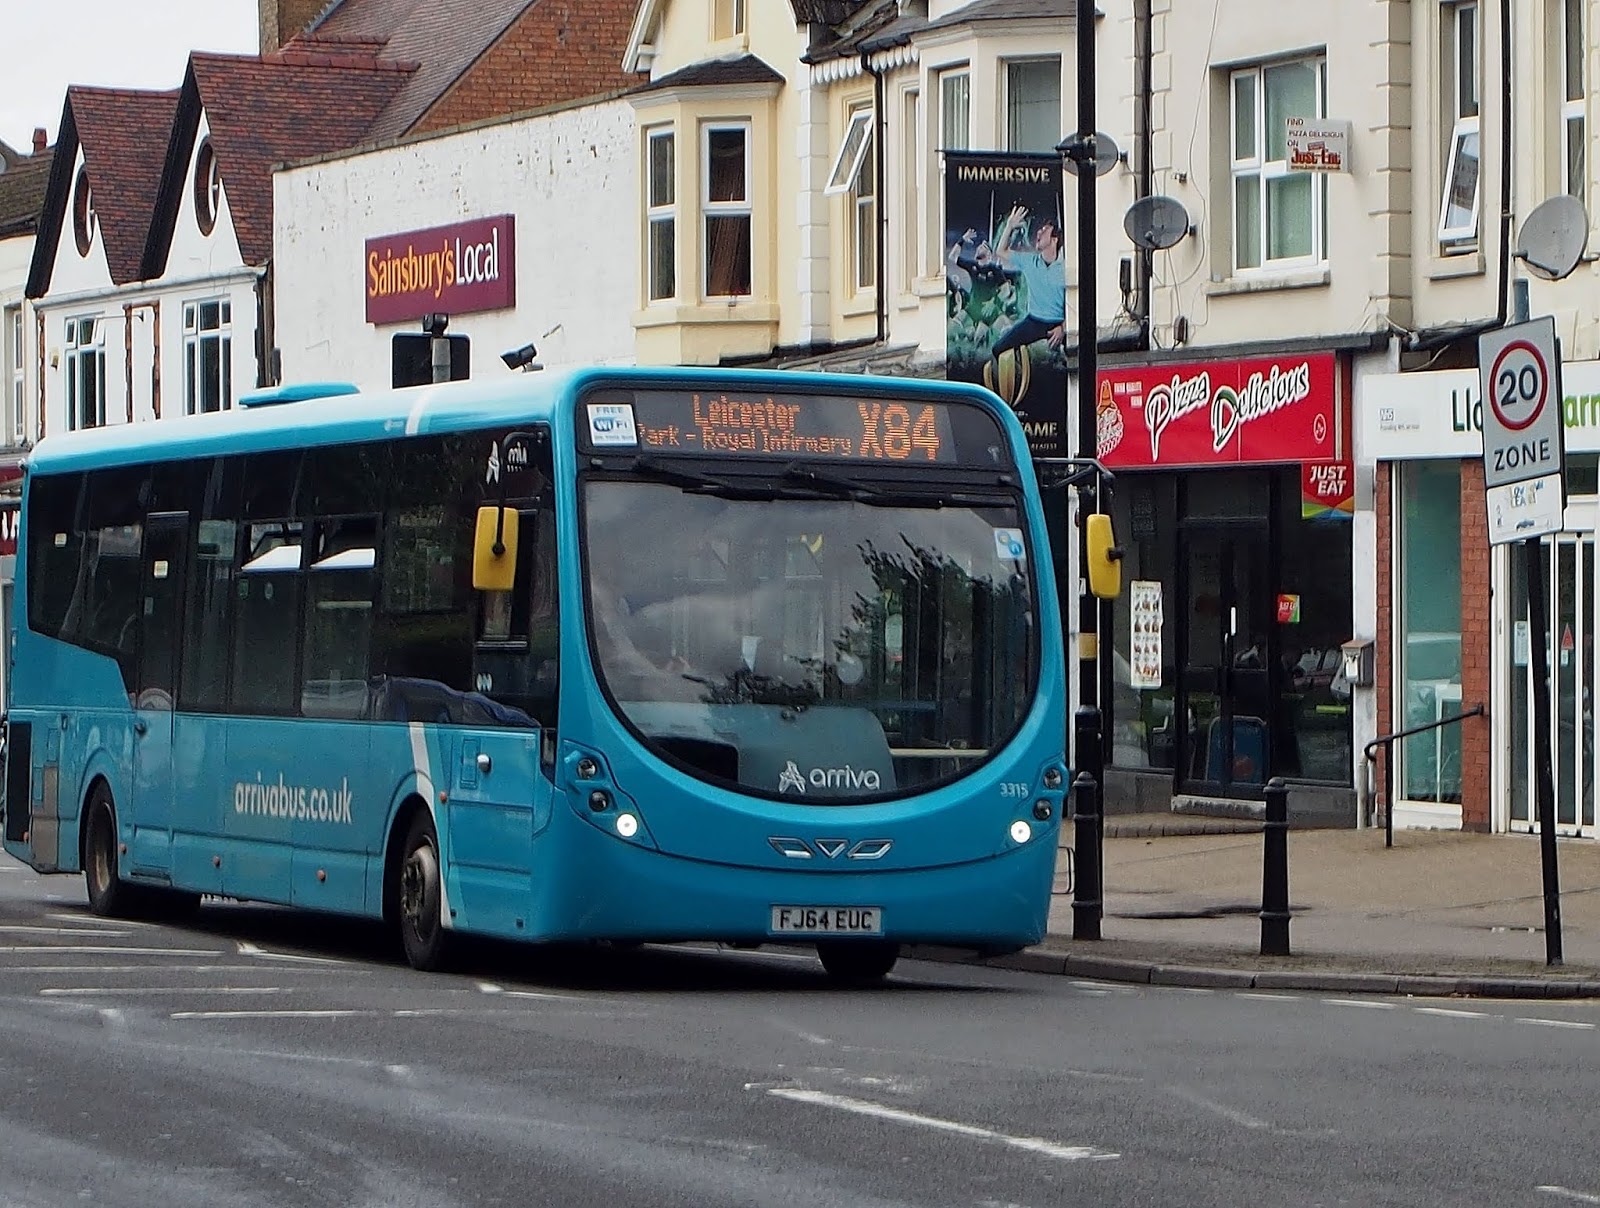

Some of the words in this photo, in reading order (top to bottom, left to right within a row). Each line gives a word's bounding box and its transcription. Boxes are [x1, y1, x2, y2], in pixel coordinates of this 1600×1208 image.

[1309, 130, 1344, 138] DELICIOUS
[957, 166, 1050, 183] IMMERSIVE
[369, 239, 454, 298] Sainsbury's
[455, 227, 499, 285] Local
[1499, 364, 1538, 407] 20
[595, 406, 624, 414] FREE
[692, 394, 800, 430] Leicester
[1144, 371, 1211, 462] Pizza
[1211, 362, 1311, 453] Delicious
[702, 424, 756, 451] Royal
[762, 429, 851, 456] Infirmary
[858, 402, 941, 461] X84
[1022, 421, 1058, 437] AME
[1494, 439, 1551, 472] ZONE
[1310, 466, 1346, 482] JUST
[1317, 480, 1346, 496] EAT
[809, 764, 880, 790] arriva
[235, 770, 352, 825] arrivabus.co.uk
[780, 909, 829, 929] FJ64
[836, 910, 873, 930] EUC
